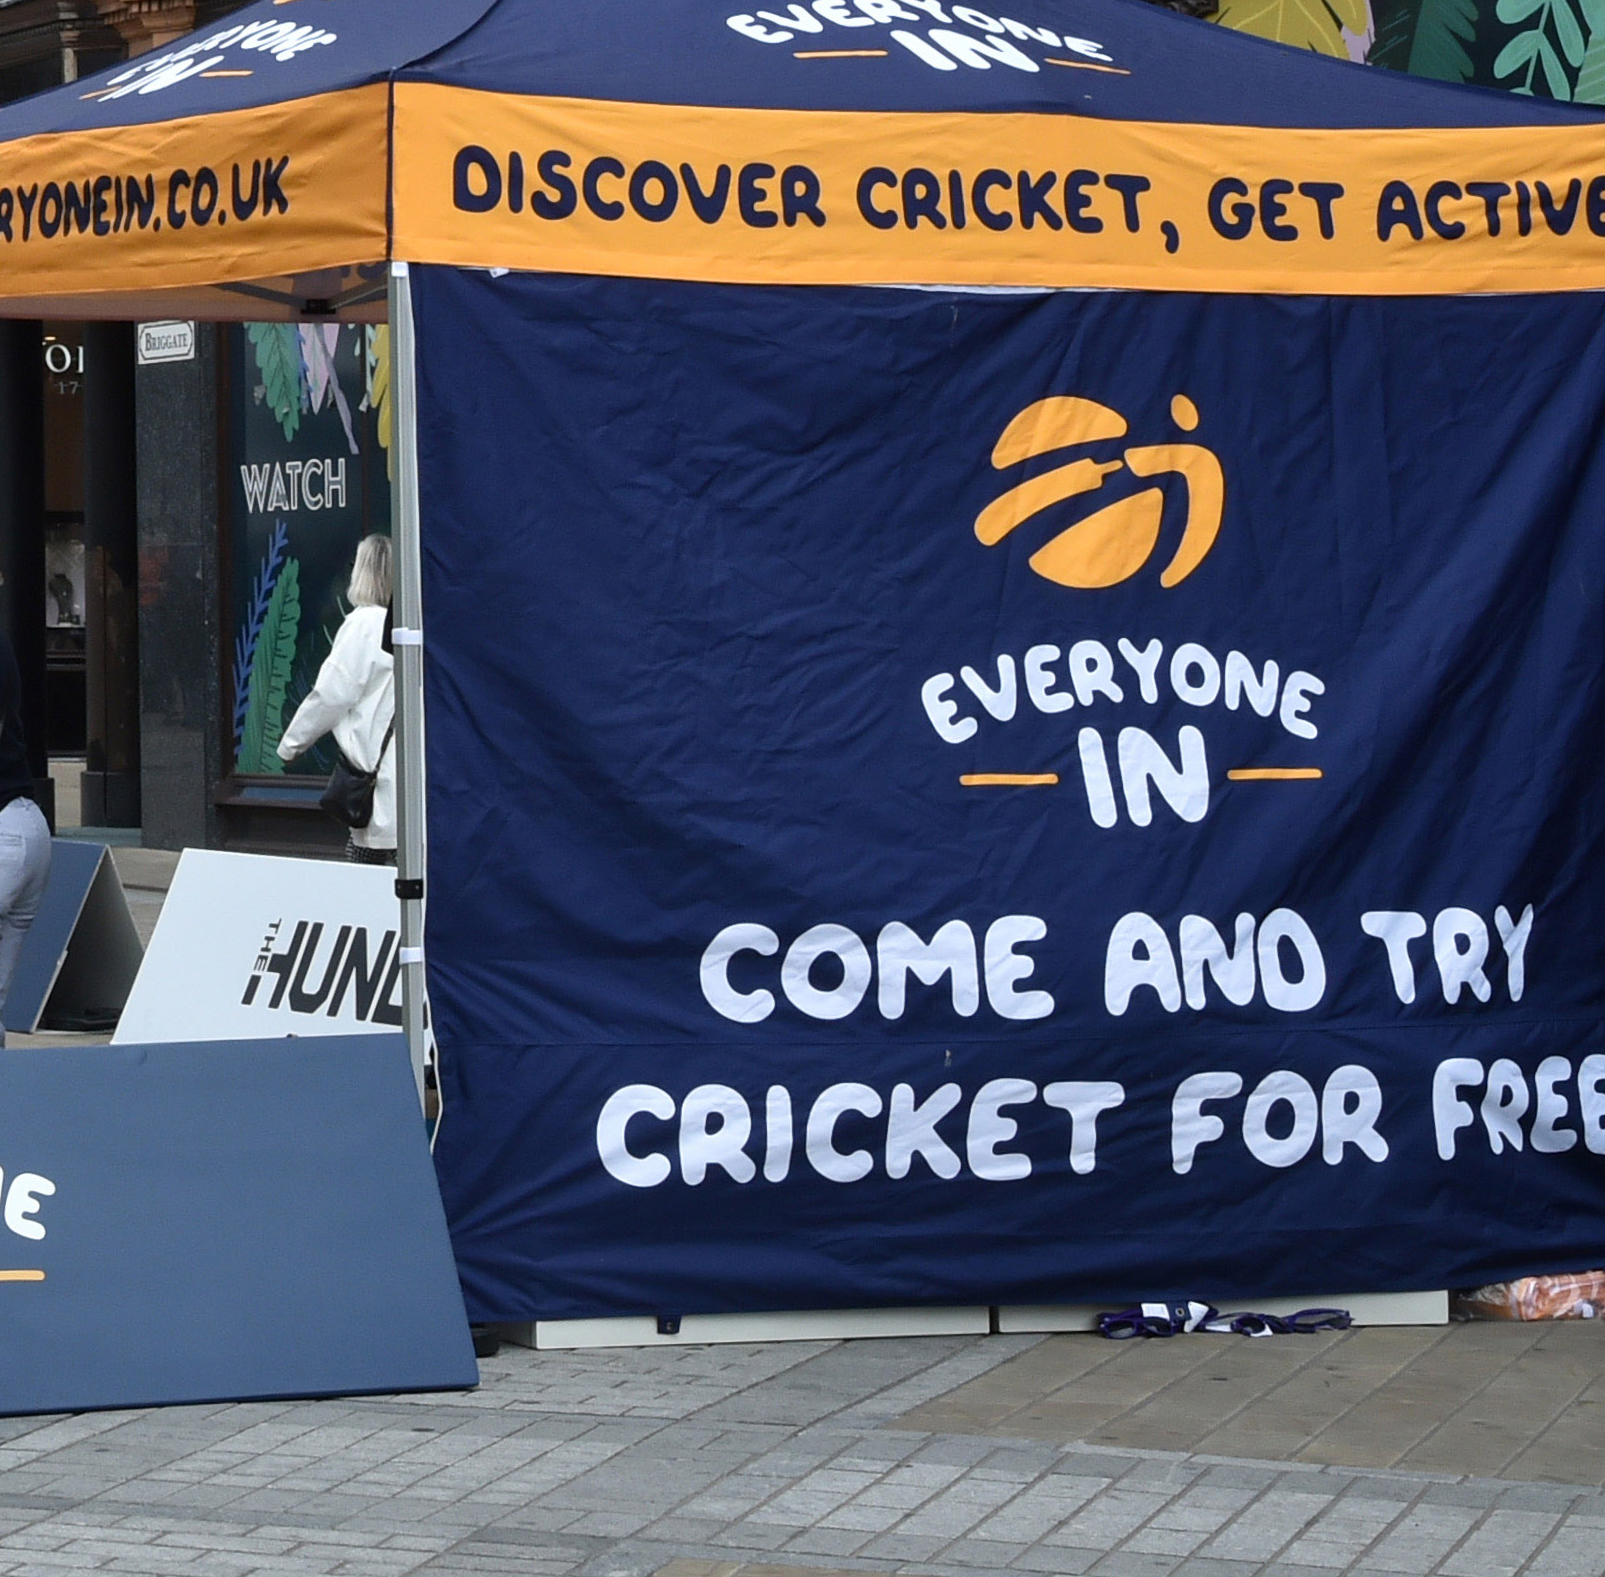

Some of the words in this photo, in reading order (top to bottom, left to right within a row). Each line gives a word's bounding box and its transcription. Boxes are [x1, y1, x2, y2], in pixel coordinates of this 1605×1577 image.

[889, 27, 1041, 74] IN
[453, 145, 826, 228] DISCOVER
[855, 167, 1181, 254] CRICKET,
[1207, 176, 1346, 242] GET
[240, 456, 348, 515] WATCH
[921, 637, 1325, 743] EVERYONE
[1077, 725, 1209, 828] IN
[253, 918, 282, 972] THE
[700, 913, 1055, 1023] COME
[1103, 907, 1326, 1015] AND
[1360, 902, 1533, 1005] TRY
[595, 1076, 1125, 1187] CRICKET
[1170, 1064, 1389, 1175] FOR
[1432, 1054, 1605, 1161] FREE
